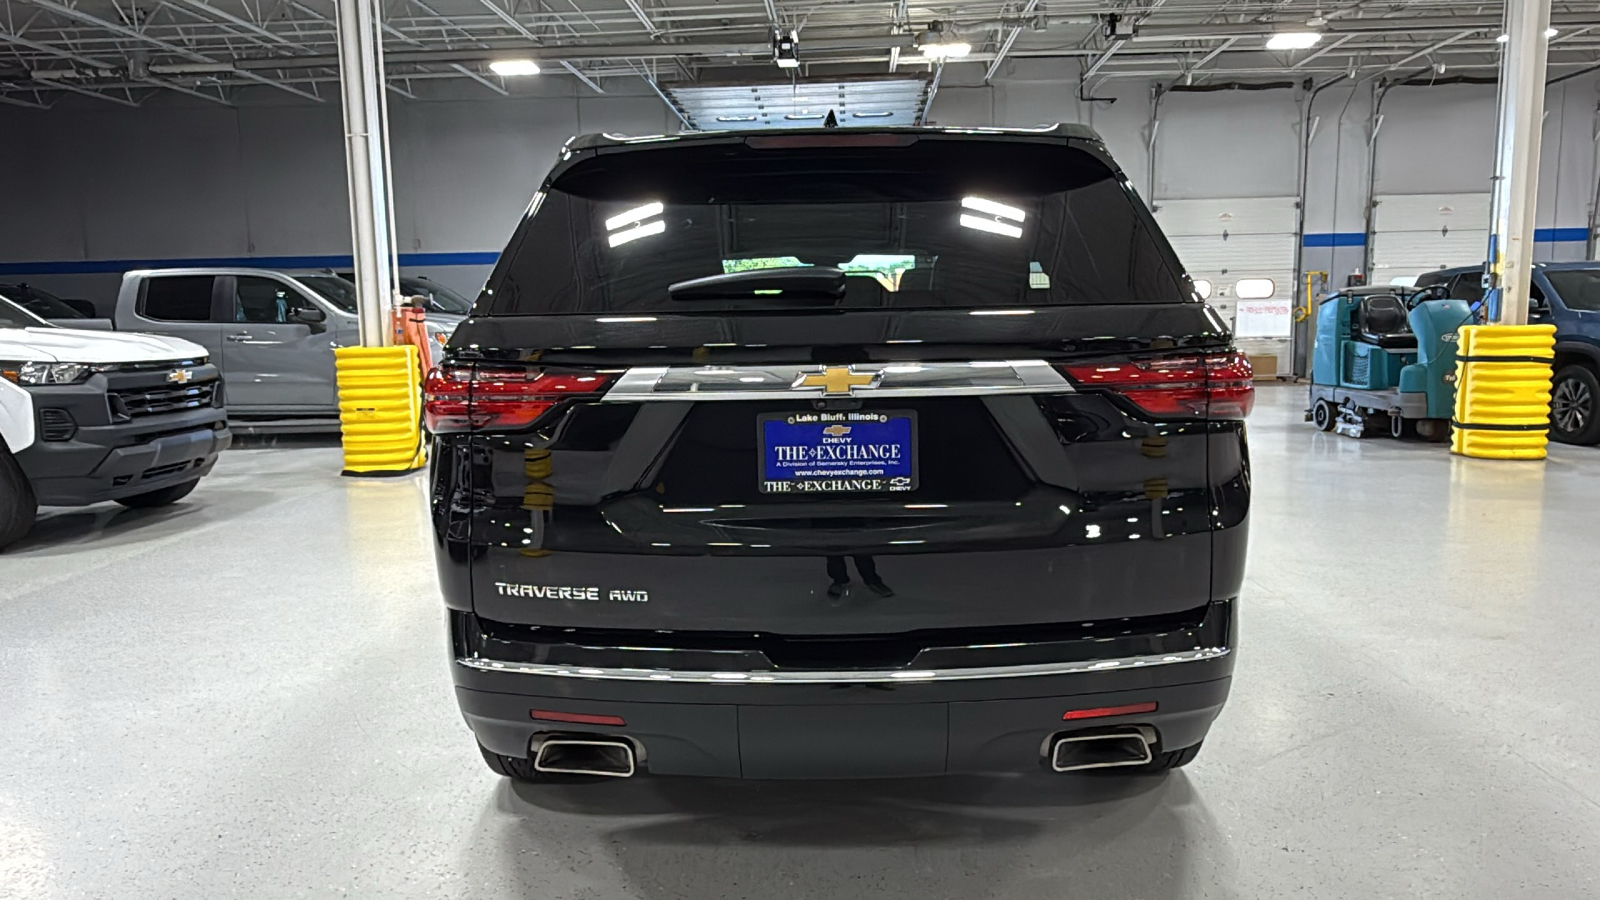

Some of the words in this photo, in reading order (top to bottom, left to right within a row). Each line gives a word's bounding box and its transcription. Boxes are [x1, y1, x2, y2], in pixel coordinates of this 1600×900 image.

[796, 413, 818, 422] Lake
[820, 412, 846, 421] Bluff,
[848, 412, 879, 420] Illinois
[774, 446, 808, 460] THE
[816, 444, 901, 459] EXCHANGE
[795, 469, 884, 477] www.chevyexchange.com
[764, 481, 791, 492] THE
[804, 479, 882, 491] EXCHANGE
[495, 582, 600, 600] TRAVERSE
[609, 590, 649, 602] AWD
